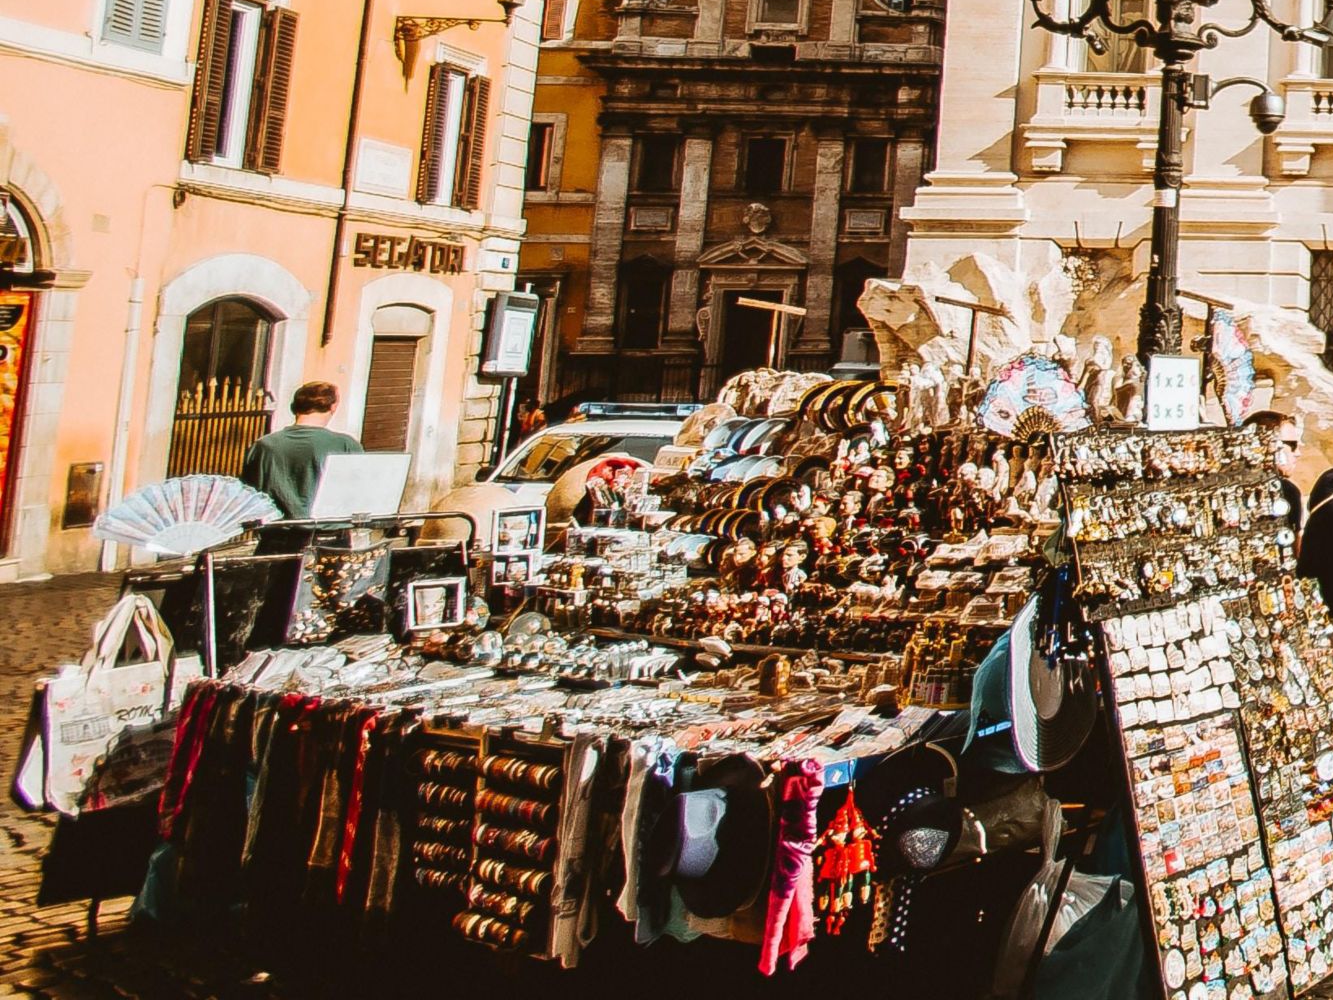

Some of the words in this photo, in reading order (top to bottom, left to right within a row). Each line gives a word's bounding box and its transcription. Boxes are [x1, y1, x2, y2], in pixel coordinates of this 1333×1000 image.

[1177, 373, 1184, 388] 2
[1153, 404, 1161, 419] 3
[1177, 404, 1184, 419] 5
